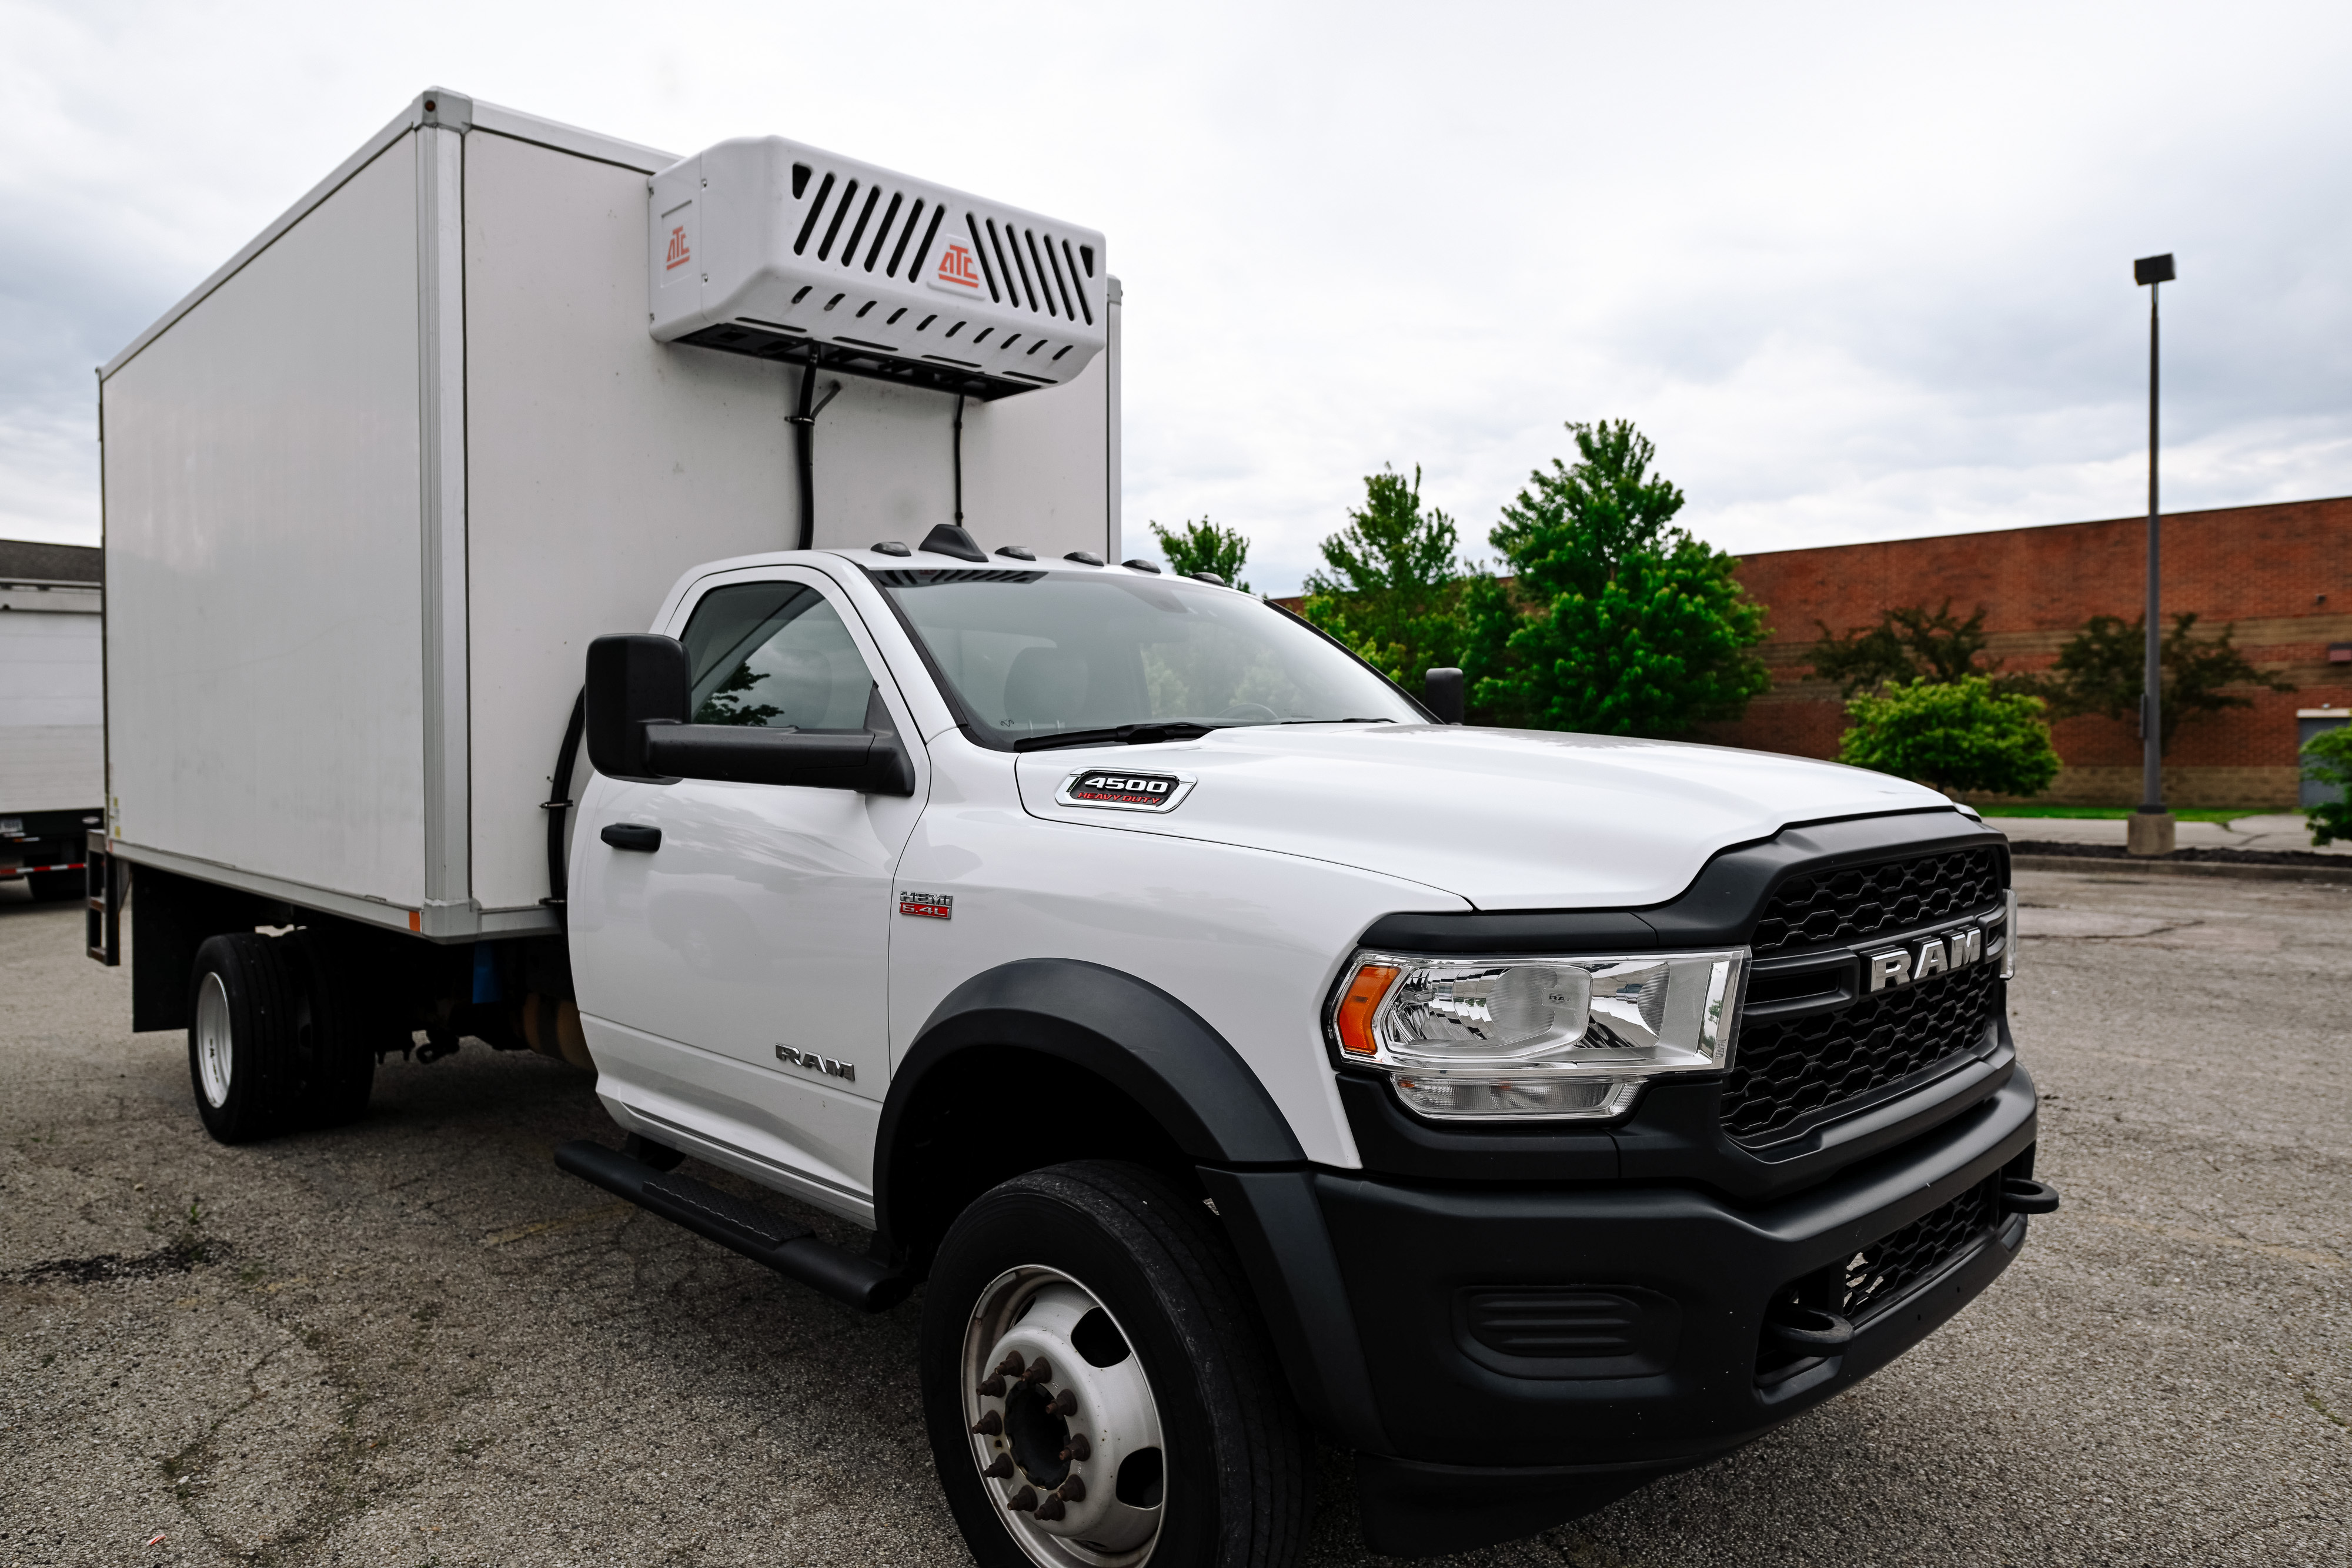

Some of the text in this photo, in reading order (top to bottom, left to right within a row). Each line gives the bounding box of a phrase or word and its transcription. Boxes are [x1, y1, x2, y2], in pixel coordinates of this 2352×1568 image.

[666, 225, 690, 262] ATC
[938, 244, 979, 280] ATC
[1077, 793, 1162, 804] HEAVY DUTY
[1084, 777, 1171, 794] 4500
[900, 891, 952, 906] HEMI
[903, 904, 946, 916] 6.4L
[1870, 928, 1982, 992] RAM
[776, 1042, 856, 1082] RAM
